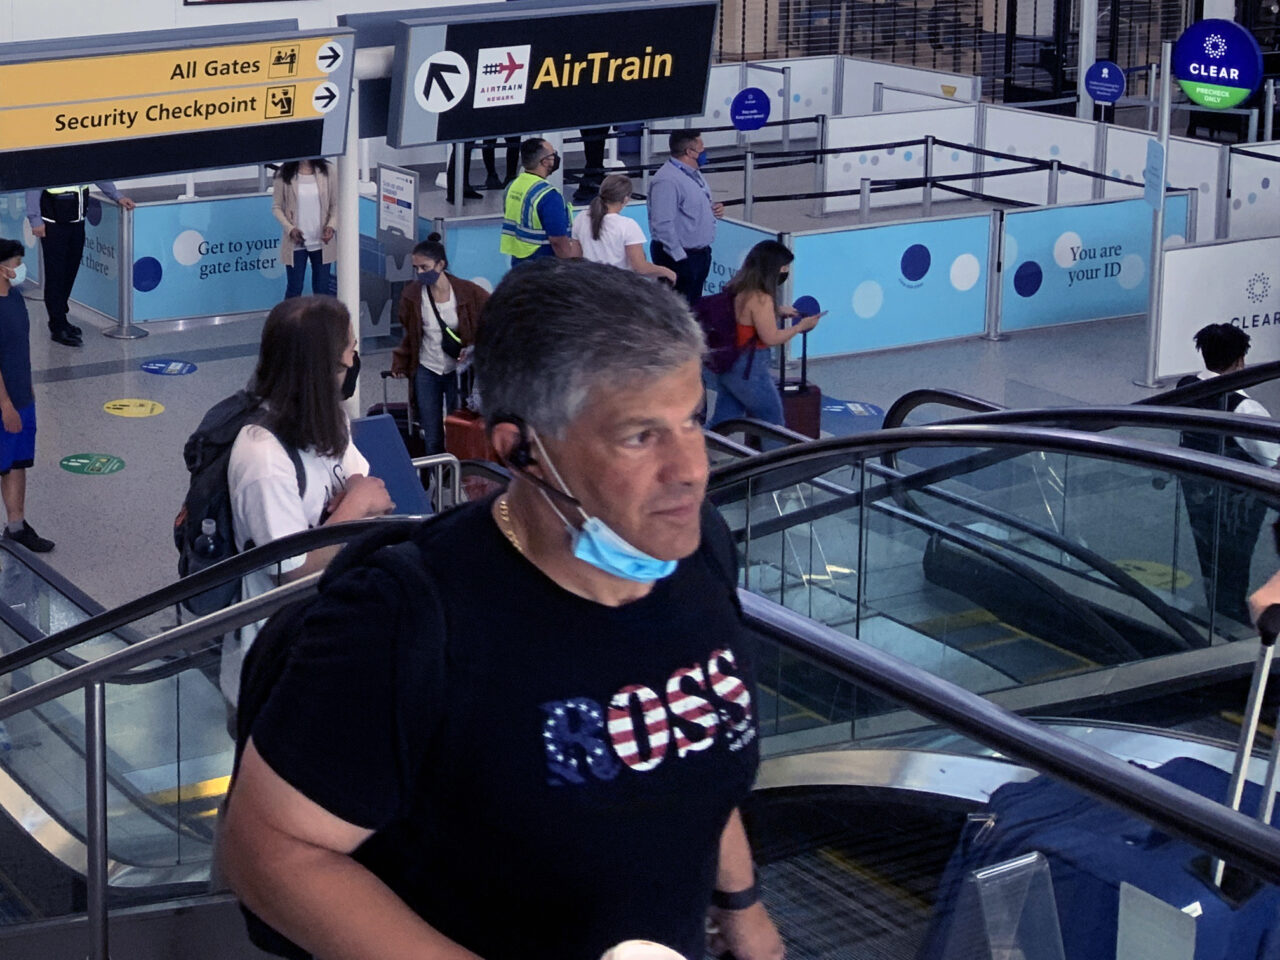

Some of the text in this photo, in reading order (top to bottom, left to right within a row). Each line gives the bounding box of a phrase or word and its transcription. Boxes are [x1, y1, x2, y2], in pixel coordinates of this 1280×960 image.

[170, 59, 261, 80] All Gates
[532, 46, 674, 90] AirTrain
[1189, 63, 1239, 80] CLEAR
[480, 84, 523, 94] AIRTRAIN
[1196, 87, 1230, 98] PRECHECK
[1204, 95, 1222, 103] ONLY
[55, 96, 257, 132] Security Checkpoint
[96, 236, 115, 259] best
[198, 238, 280, 257] Get to your
[1070, 245, 1122, 261] You are
[86, 253, 109, 276] there
[200, 256, 277, 280] gate faster
[712, 261, 726, 276] to
[1068, 262, 1122, 287] your ID
